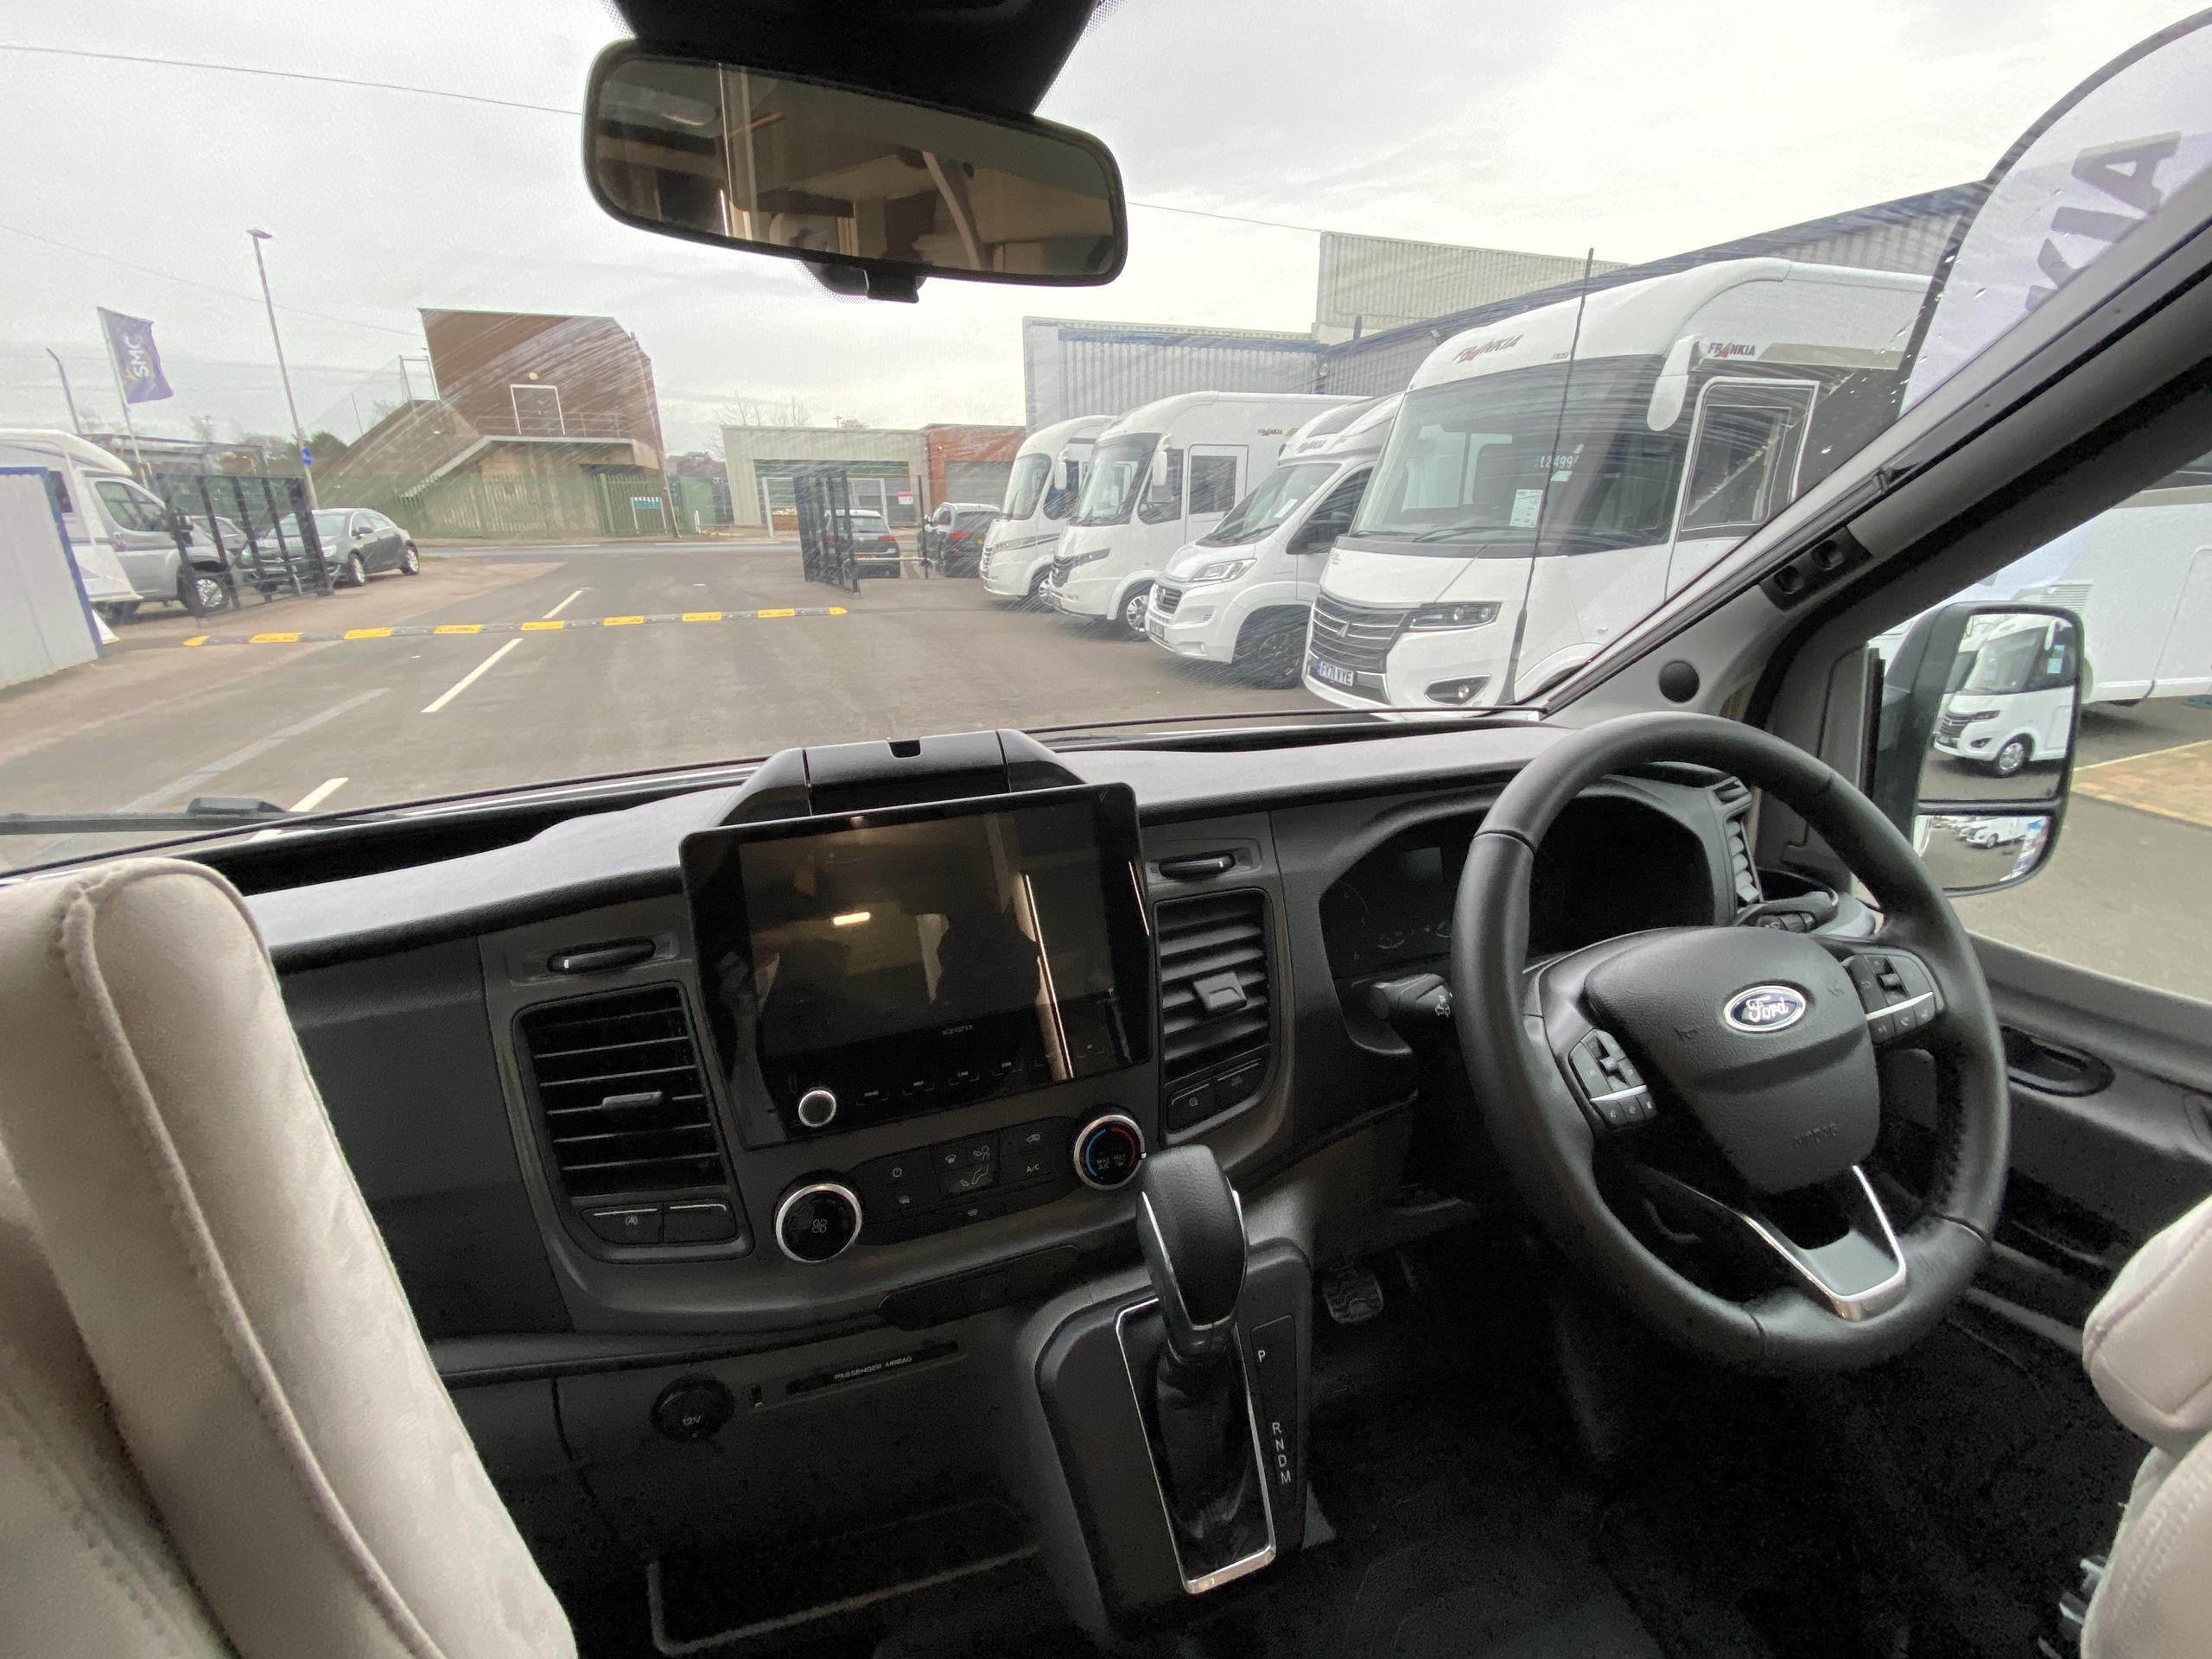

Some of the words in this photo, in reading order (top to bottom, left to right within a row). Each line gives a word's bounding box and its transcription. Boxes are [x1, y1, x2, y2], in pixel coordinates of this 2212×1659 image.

[1707, 342, 1756, 358] FRANKIA
[1745, 995, 1789, 1023] Ford
[1027, 1163, 1039, 1173] A/C
[1257, 1350, 1266, 1363] P
[834, 1363, 882, 1380] PASSENGER
[1272, 1421, 1282, 1435] R
[1275, 1438, 1285, 1452] N
[1278, 1454, 1287, 1468] D
[1281, 1470, 1292, 1485] M
